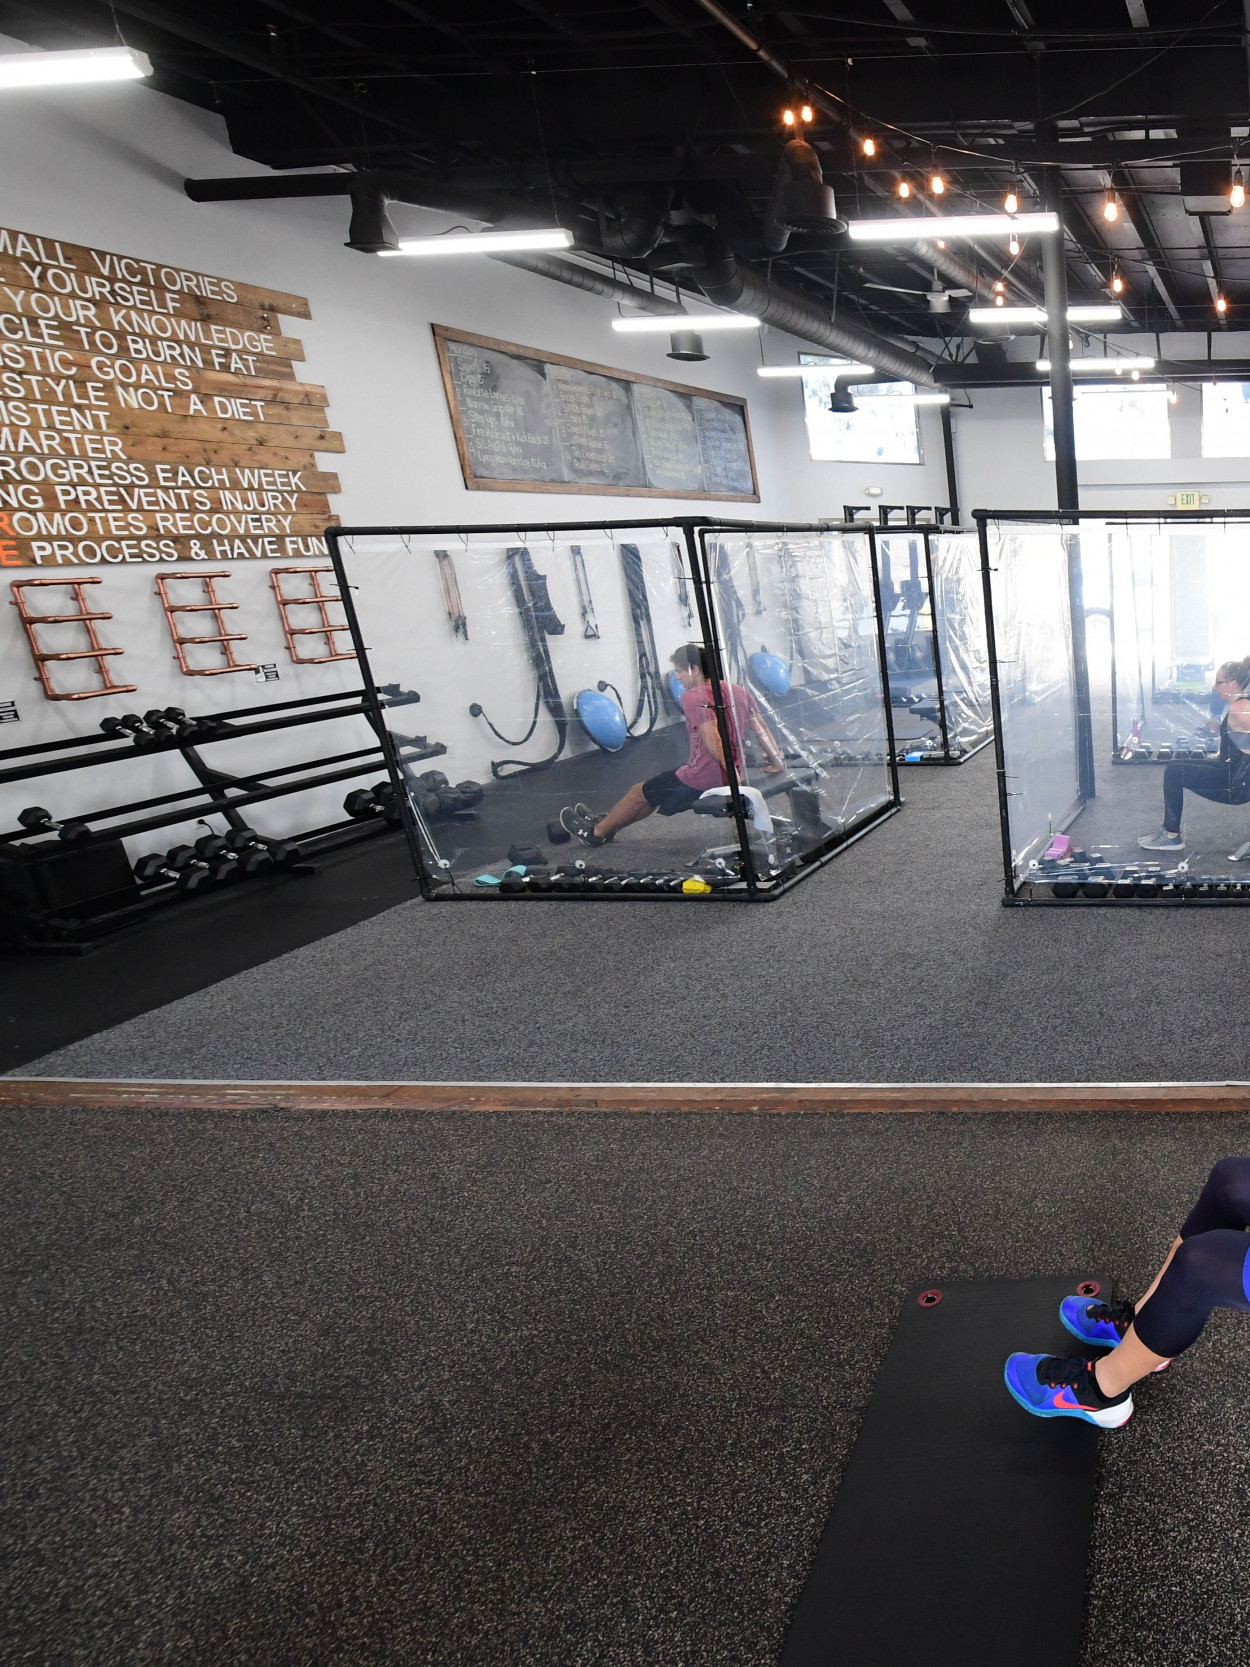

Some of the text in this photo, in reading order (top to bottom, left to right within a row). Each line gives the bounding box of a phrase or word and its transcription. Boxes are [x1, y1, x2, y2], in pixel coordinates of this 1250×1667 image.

[20, 261, 182, 315] YOURSELF
[90, 250, 238, 303] VICTORIES
[2, 286, 277, 356] YOUR KNOWLEDGE
[0, 313, 258, 376] CLE TO BURN FAT
[0, 342, 193, 390] STIC GOALS
[116, 385, 174, 412] NOT
[188, 393, 208, 416] A
[214, 397, 265, 421] DIET
[0, 456, 306, 491] ROGRESS EACH WEEK
[55, 485, 211, 511] PREVENTS
[219, 492, 299, 512] INJURY
[1181, 494, 1195, 505] EXIT
[155, 514, 293, 536] RECOVERY
[30, 540, 179, 565] PROCESS
[190, 539, 208, 560] &
[213, 537, 281, 559] HAVE
[285, 536, 329, 556] FUN
